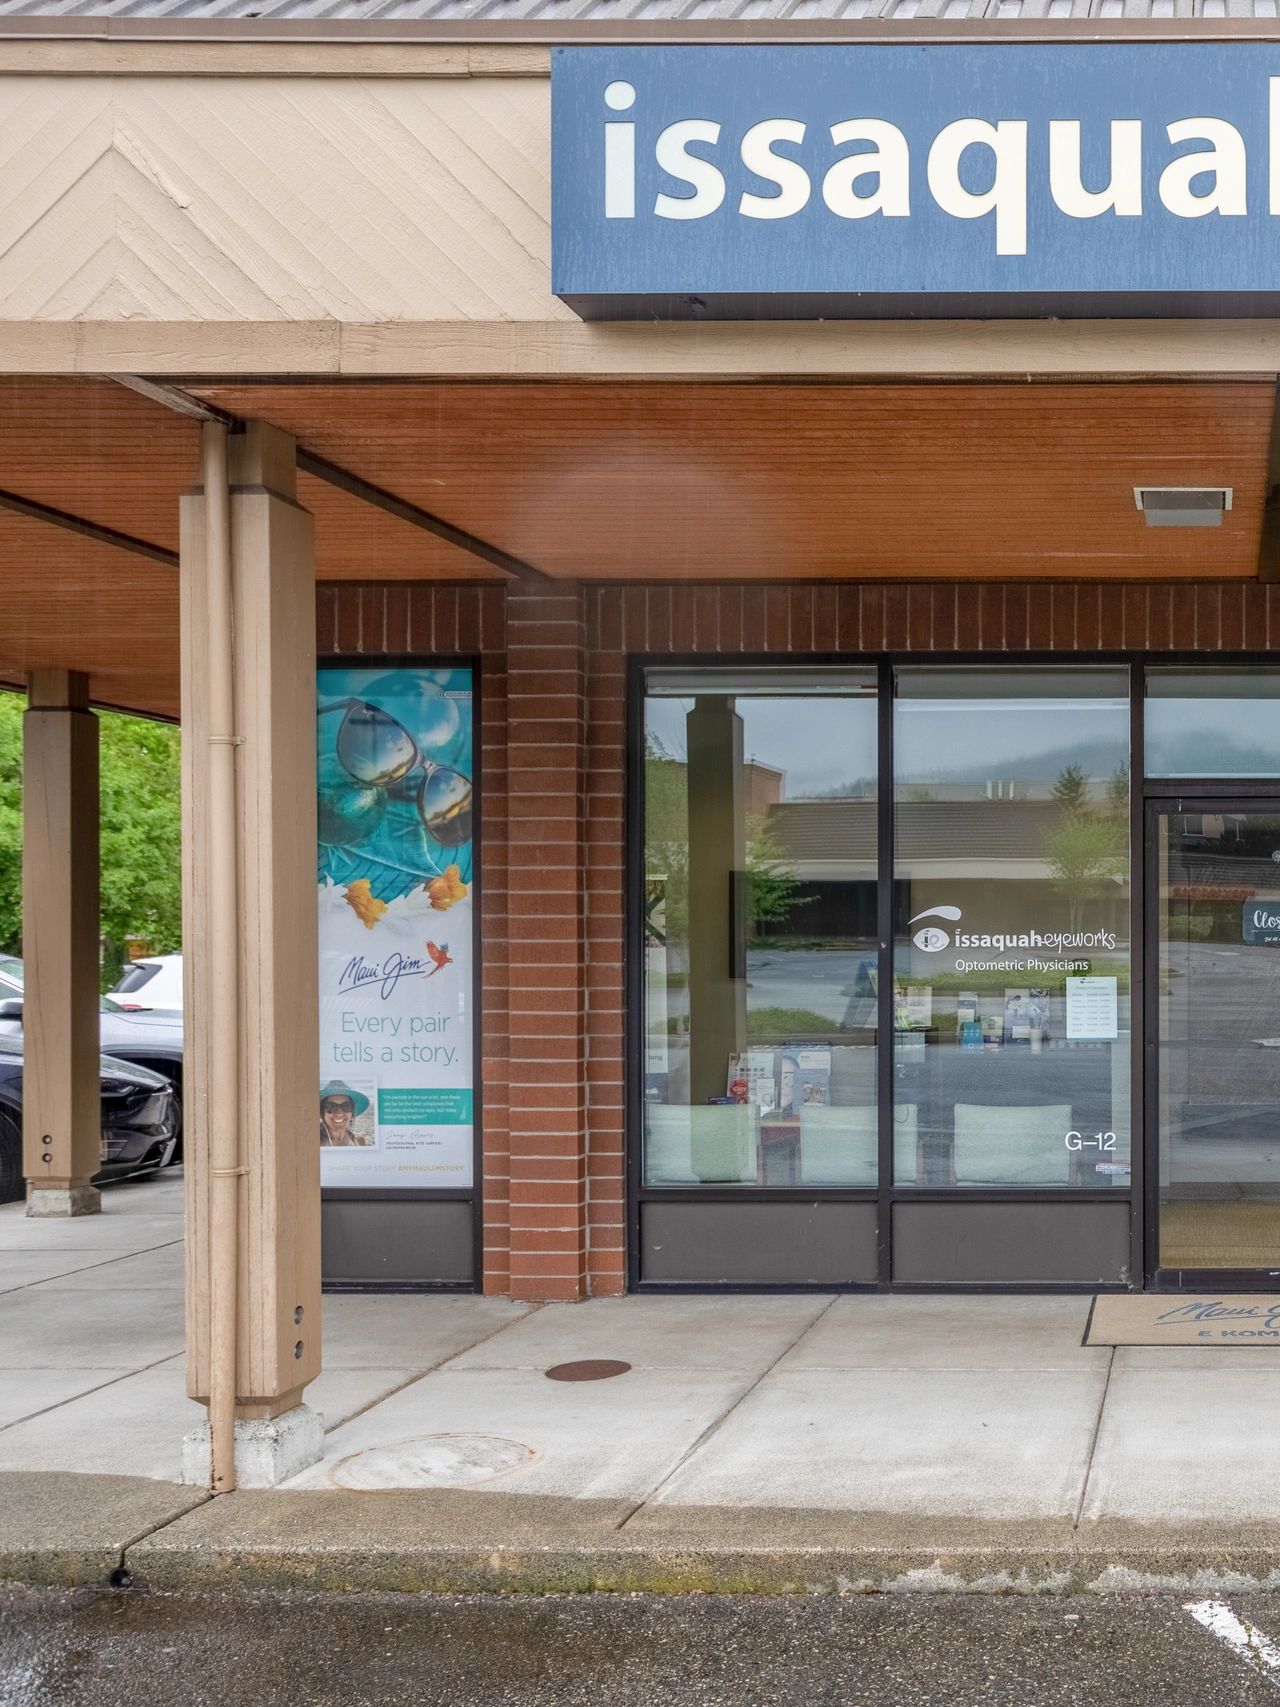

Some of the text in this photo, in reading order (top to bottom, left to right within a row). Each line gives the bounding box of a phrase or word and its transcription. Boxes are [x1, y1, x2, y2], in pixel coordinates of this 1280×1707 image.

[955, 928, 1116, 953] issaquah eyeworks
[338, 952, 424, 1001] Maui Jim
[955, 959, 1089, 973] Optometric Physicians
[342, 1012, 451, 1037] Every pair
[333, 1042, 459, 1067] tells a story.
[1065, 1131, 1117, 1151] G-12
[1157, 1301, 1258, 1320] Maui
